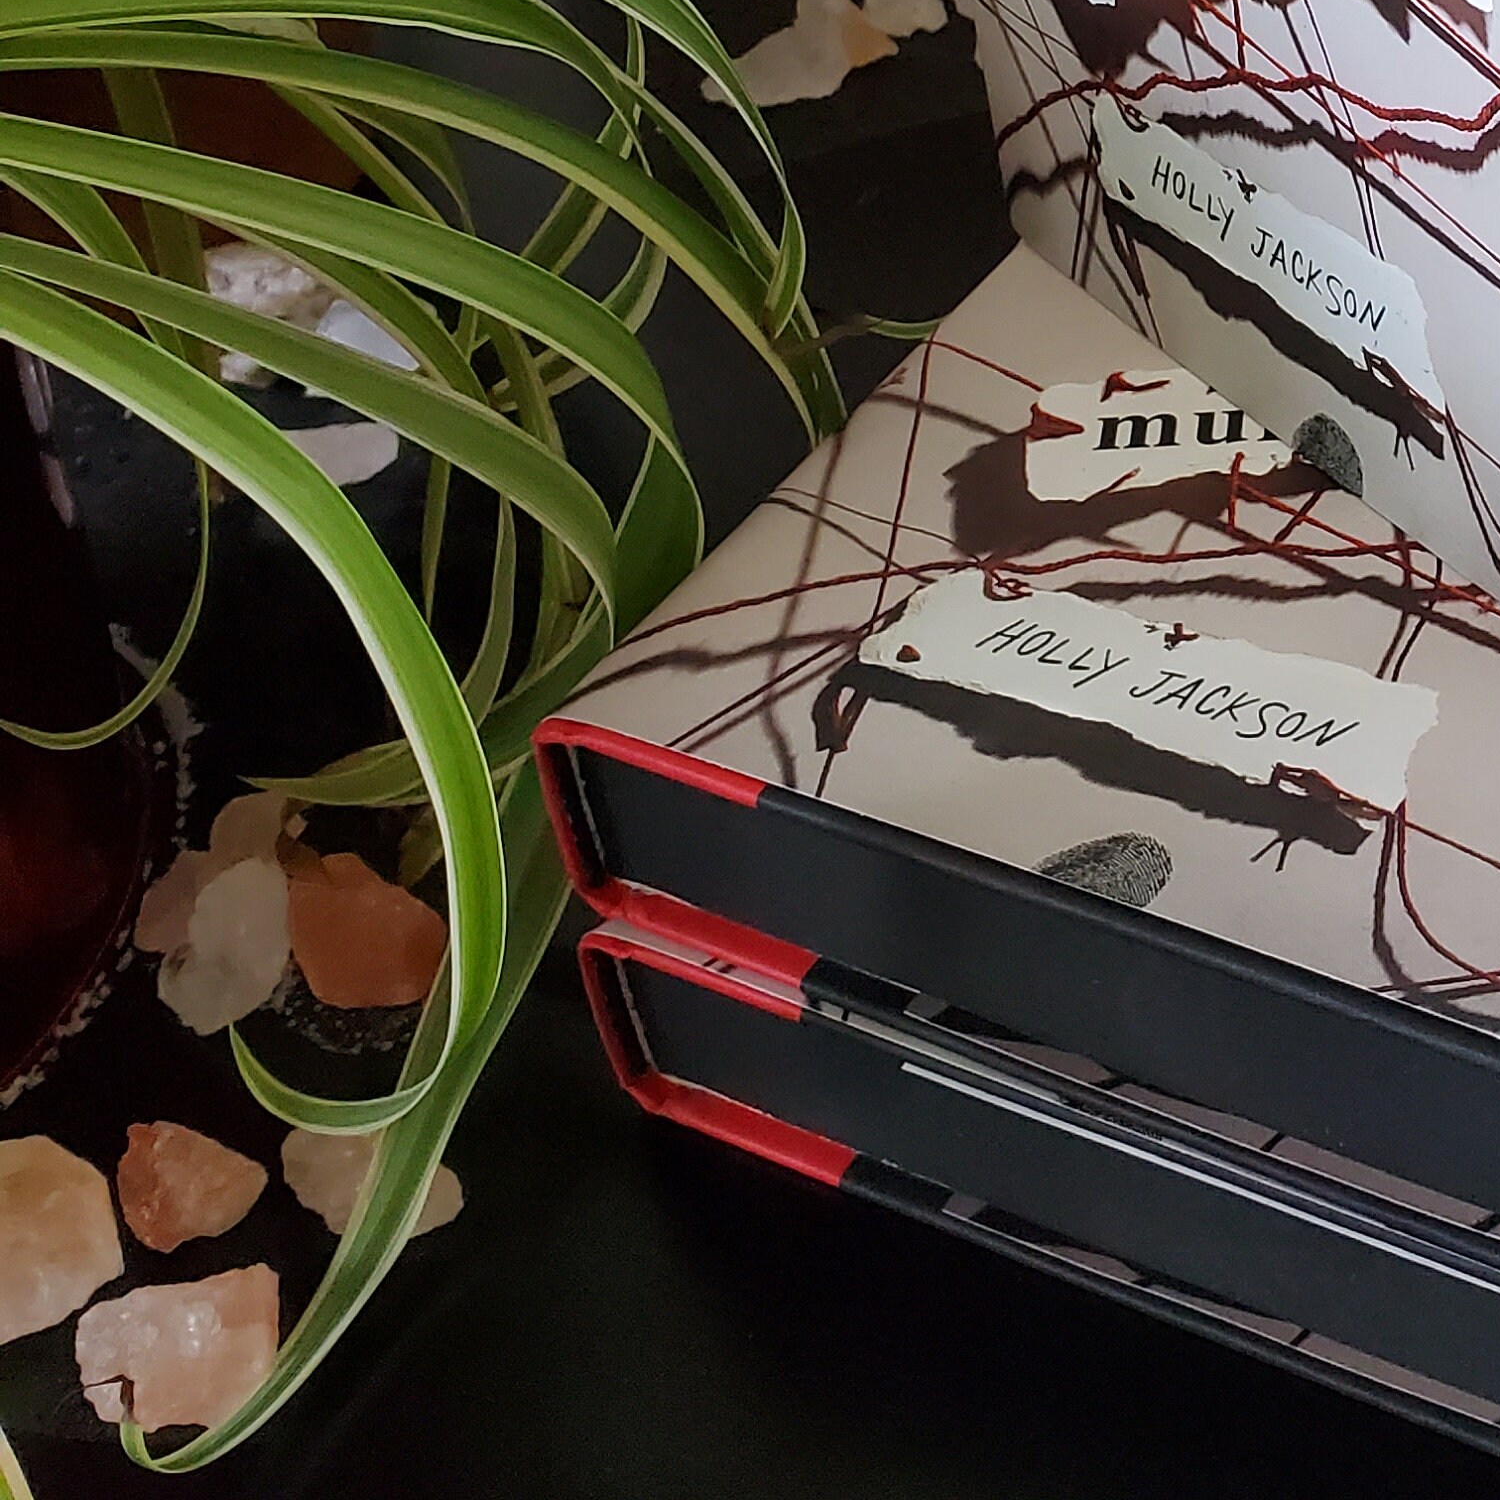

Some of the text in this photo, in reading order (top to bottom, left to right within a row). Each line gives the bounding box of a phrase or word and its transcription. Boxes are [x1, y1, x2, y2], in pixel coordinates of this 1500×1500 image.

[1150, 155, 1387, 332] HOLLY JACKSON
[975, 618, 1361, 748] HOLLY JACKSON
